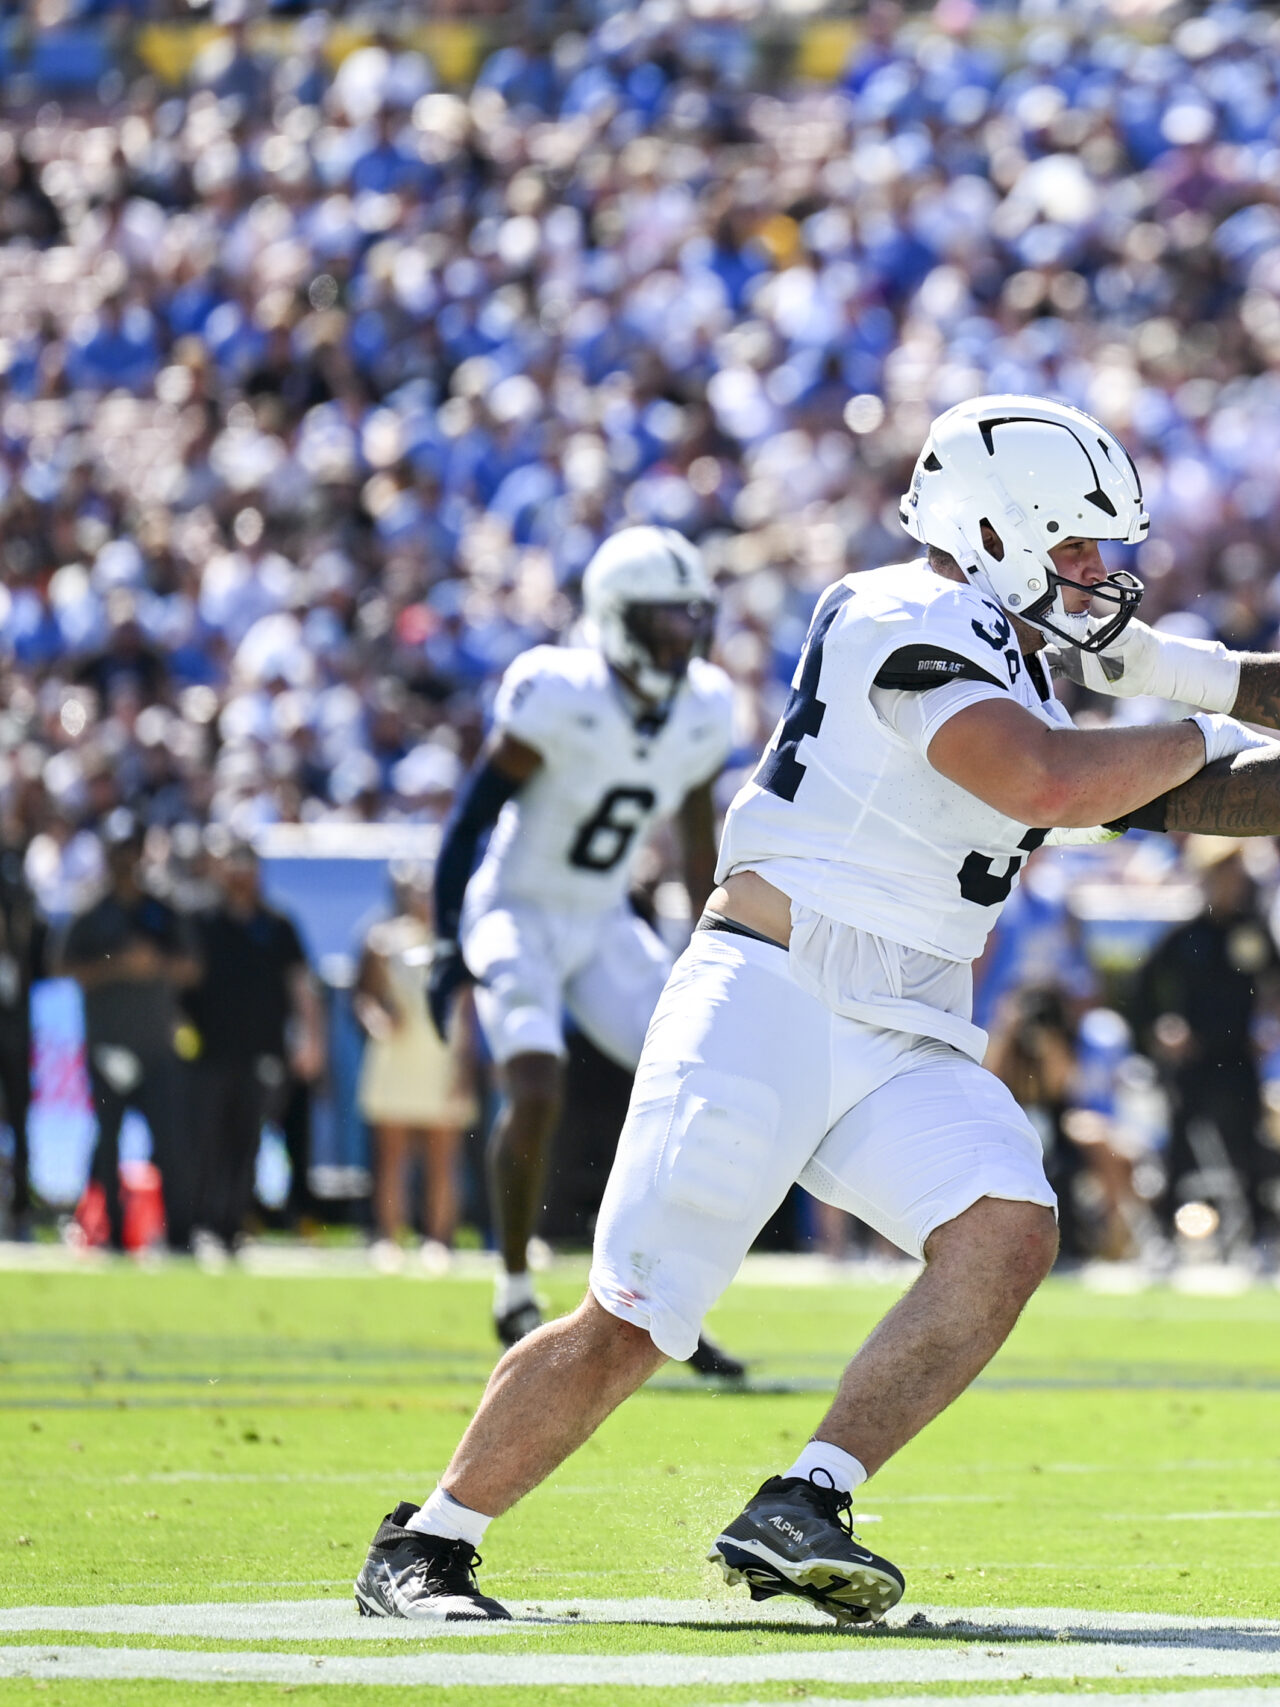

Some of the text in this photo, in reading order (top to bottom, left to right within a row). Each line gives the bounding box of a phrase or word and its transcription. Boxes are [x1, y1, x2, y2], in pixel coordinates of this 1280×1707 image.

[917, 660, 962, 673] DOUGLAS
[568, 785, 656, 873] 6
[769, 1515, 804, 1544] ALPHA
